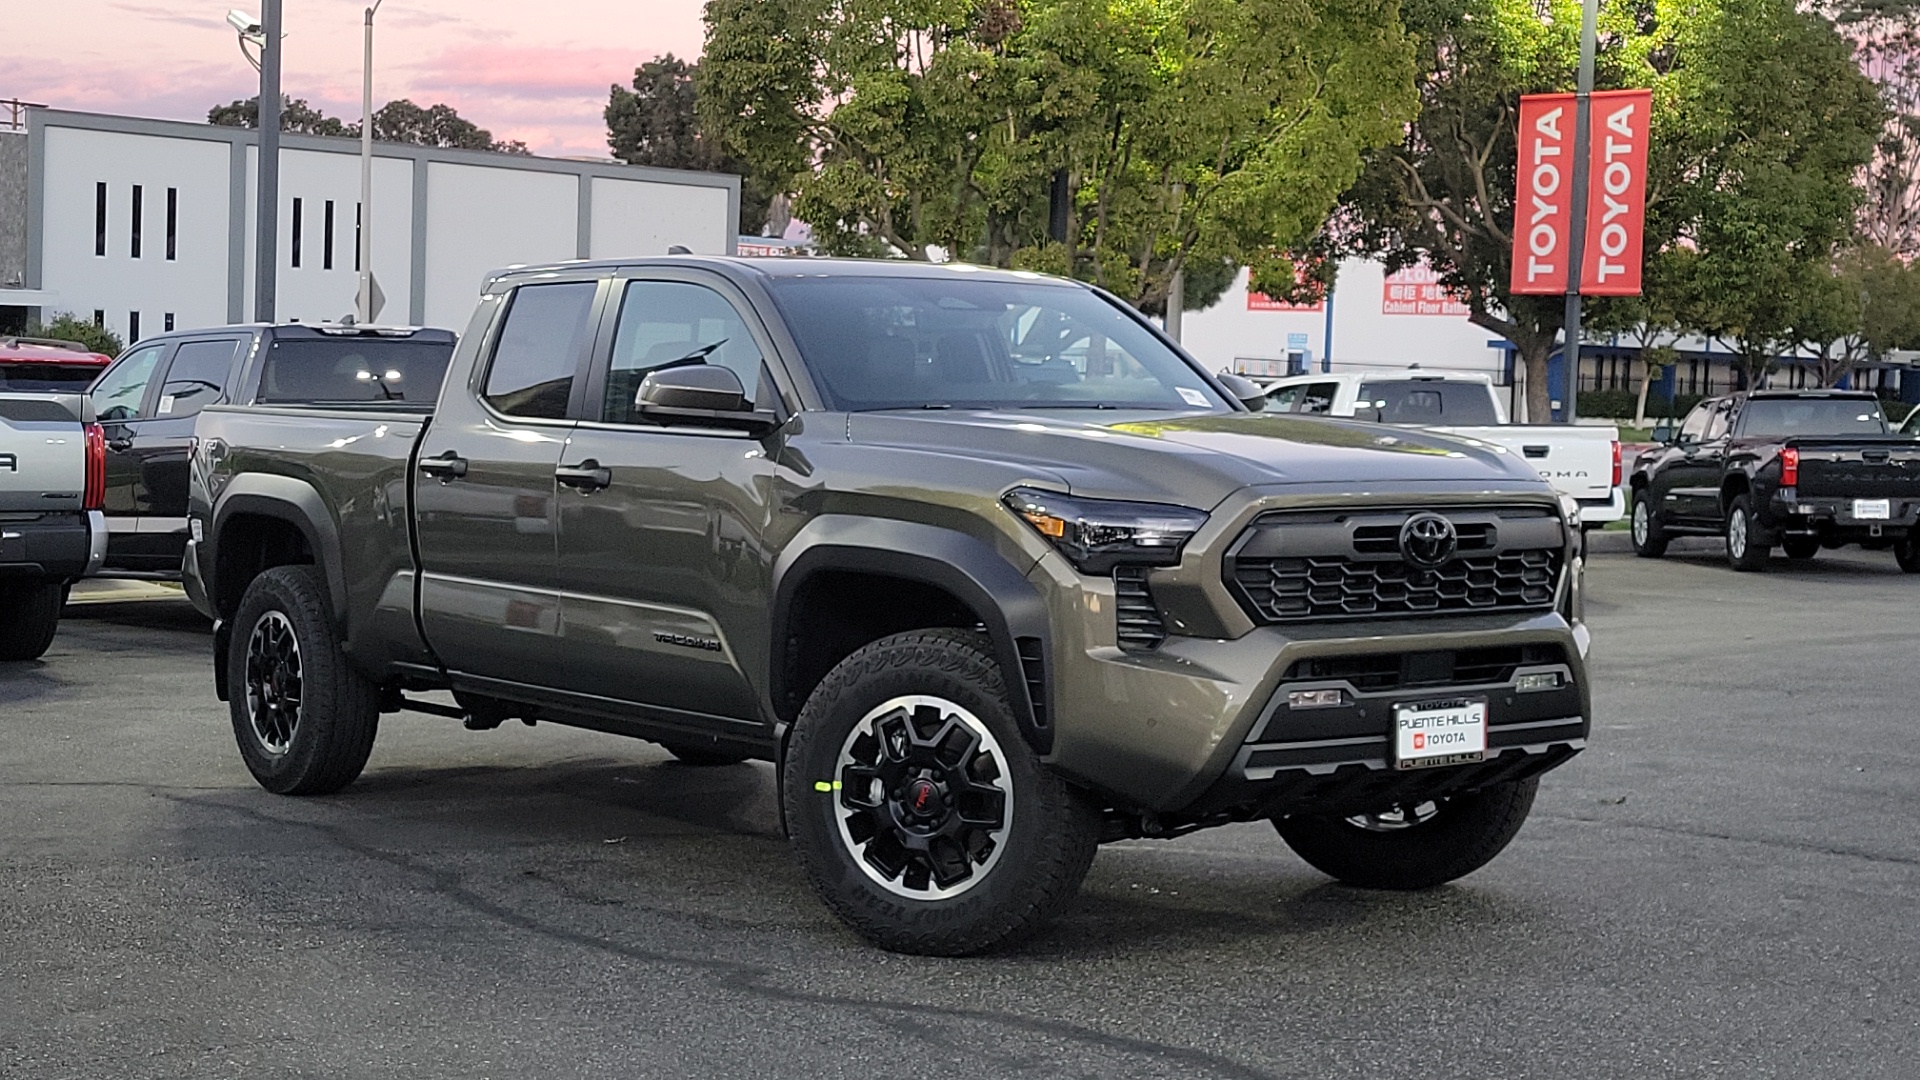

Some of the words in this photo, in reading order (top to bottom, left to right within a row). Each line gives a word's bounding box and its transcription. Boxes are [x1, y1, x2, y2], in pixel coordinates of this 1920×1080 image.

[1528, 106, 1563, 282] TOYOTA
[1598, 103, 1634, 283] TOYOTA
[1418, 302, 1440, 313] Floor
[1419, 700, 1465, 711] TOYOTA
[1399, 716, 1445, 731] PUENTE
[1446, 713, 1481, 726] HILLS
[1427, 732, 1466, 745] TOYOTA
